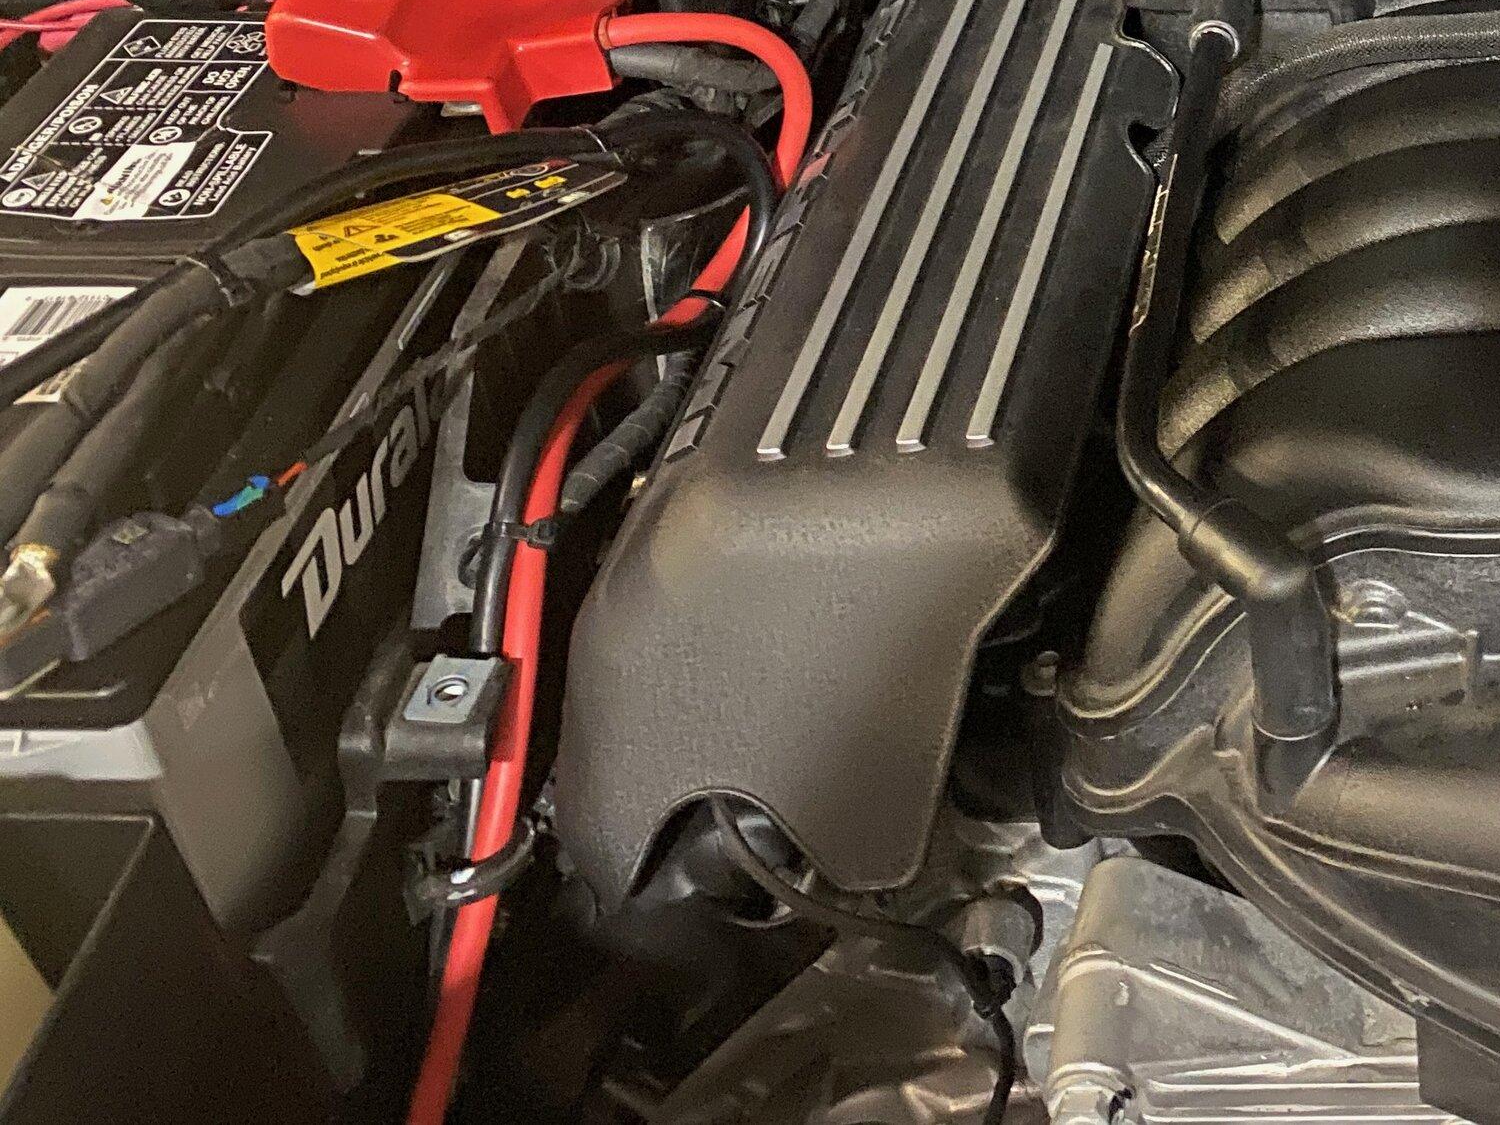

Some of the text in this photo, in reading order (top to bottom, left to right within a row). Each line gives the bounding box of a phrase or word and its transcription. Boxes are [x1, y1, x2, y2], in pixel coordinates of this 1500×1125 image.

[200, 71, 222, 83] DO
[212, 69, 237, 85] NOT
[231, 147, 258, 170] Battery
[191, 143, 248, 204] NON-SPILLABLE
